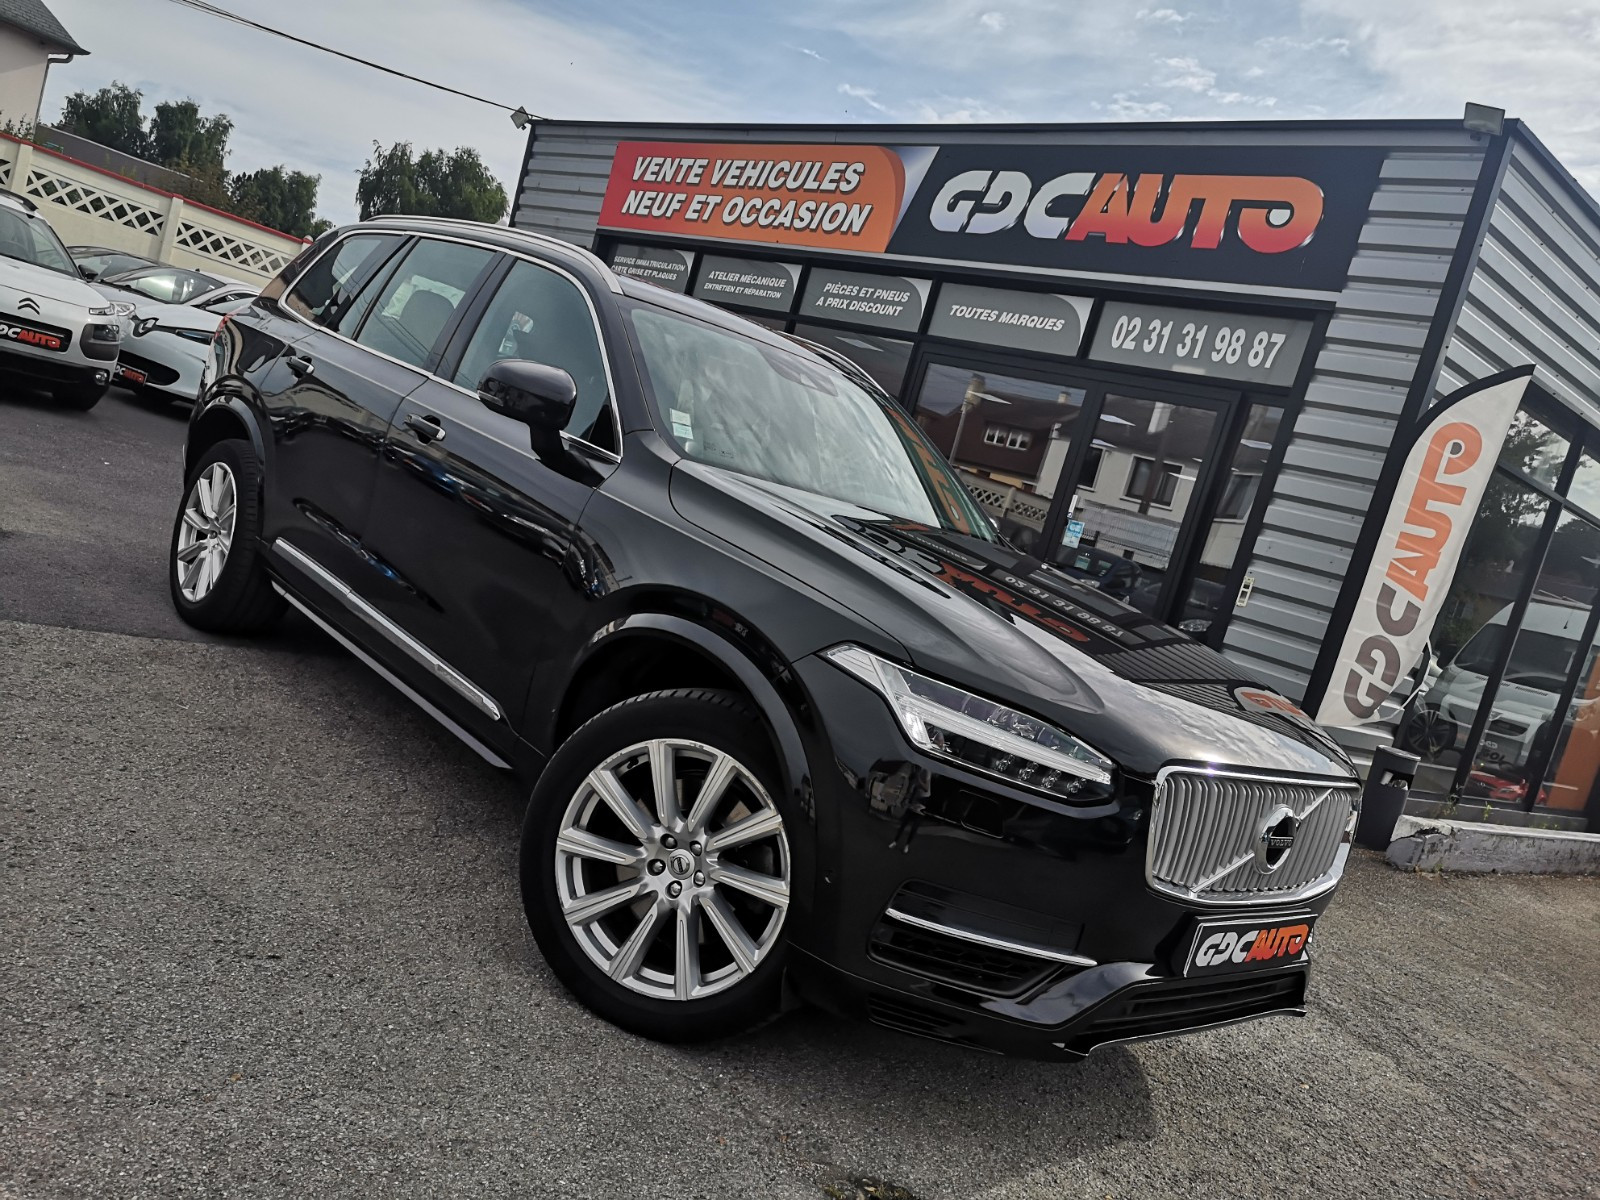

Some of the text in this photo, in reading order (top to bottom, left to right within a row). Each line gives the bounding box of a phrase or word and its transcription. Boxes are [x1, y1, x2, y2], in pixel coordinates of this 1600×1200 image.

[631, 156, 865, 193] VENTE VEHICULES
[621, 190, 873, 234] NEUF ET OCCASION
[613, 255, 686, 272] SERVICE IMMATRICULATION
[627, 266, 644, 276] GRISE
[643, 268, 652, 277] ET
[651, 270, 678, 281] PLAQUES
[703, 282, 782, 299] ENTRETIEN ET RÉPARATION
[708, 270, 787, 288] ATELIER MÉCANIQUE
[823, 281, 911, 303] PIÈCES ET PNEUS
[815, 296, 904, 317] A PRIX DISCOUNT
[949, 304, 1066, 332] TOUTES MARQUES
[0, 324, 61, 349] DCAUTO
[1111, 315, 1287, 369] 02 31 31 98 87
[1195, 923, 1310, 967] GDCAUTO
